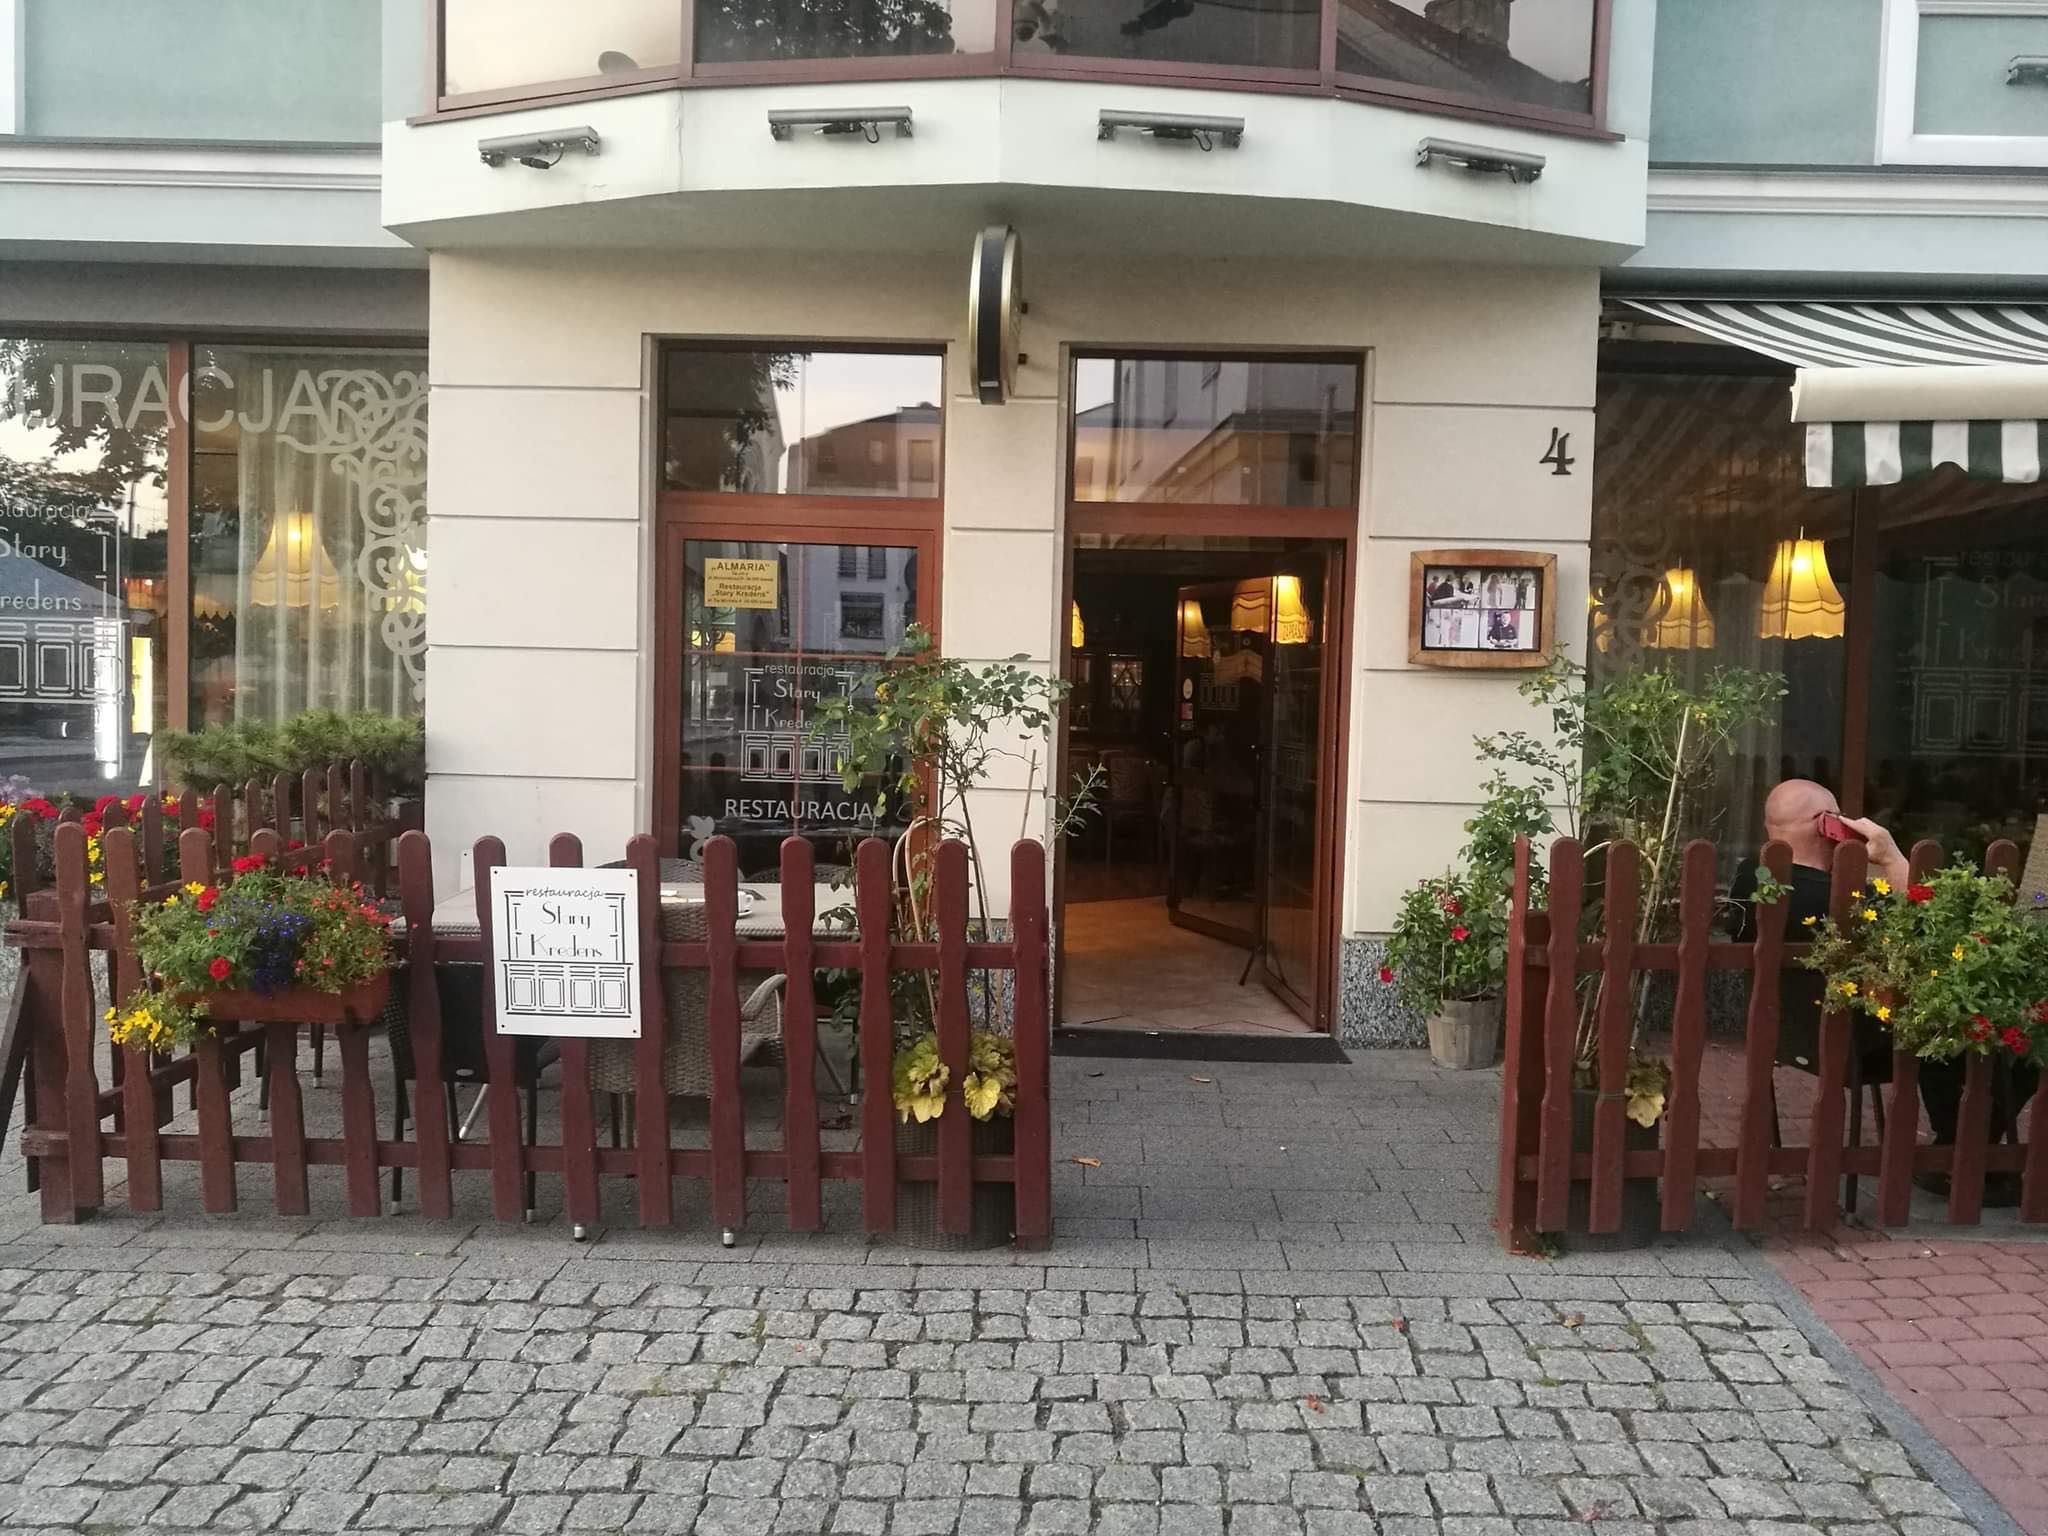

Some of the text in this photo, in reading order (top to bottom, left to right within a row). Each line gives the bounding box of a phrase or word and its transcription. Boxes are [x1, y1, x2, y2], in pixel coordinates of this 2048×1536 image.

[1539, 427, 1575, 475] 4
[764, 663, 835, 678] restauracja
[773, 679, 820, 703] Stary
[765, 708, 814, 729] Krede
[724, 799, 874, 821] RESTAURACJA
[525, 886, 602, 900] restauracja
[541, 901, 591, 929] Stary
[530, 933, 603, 958] Kredens
